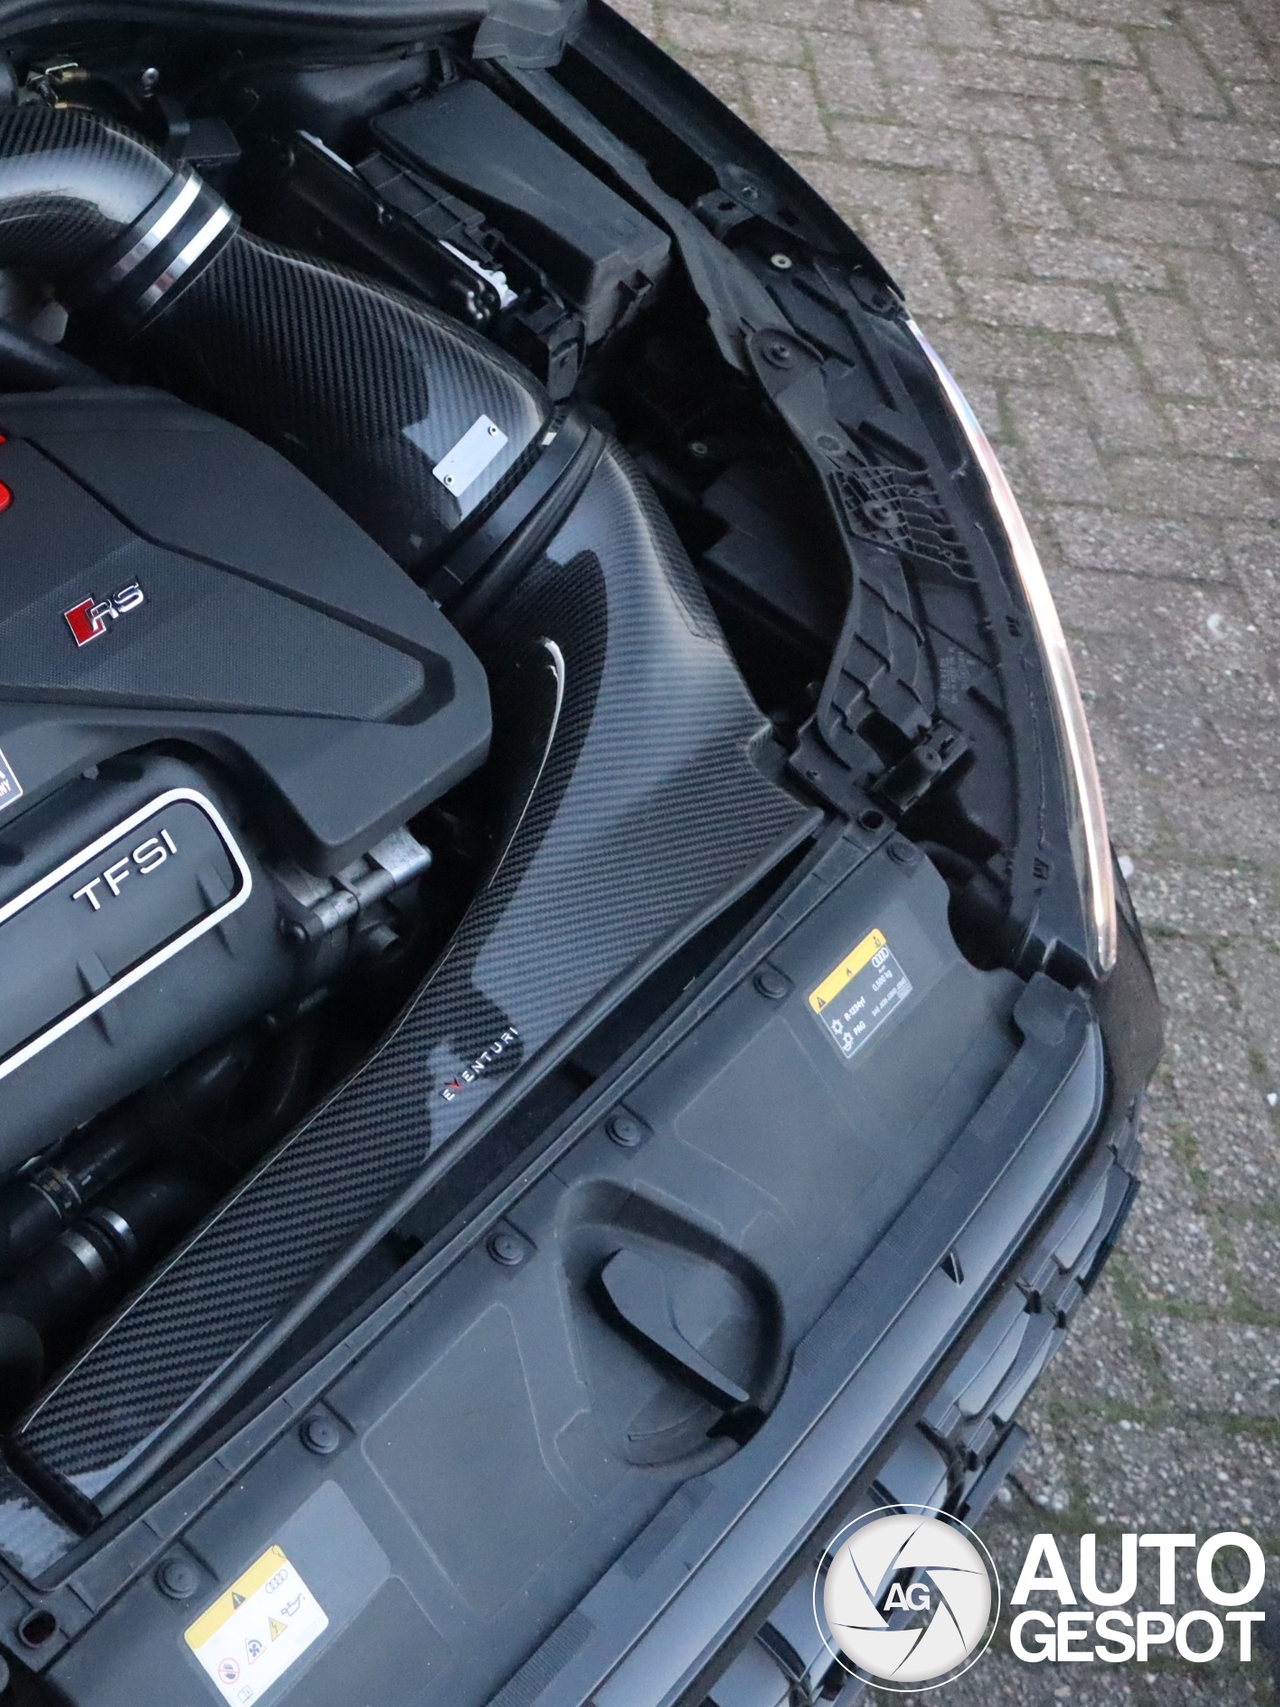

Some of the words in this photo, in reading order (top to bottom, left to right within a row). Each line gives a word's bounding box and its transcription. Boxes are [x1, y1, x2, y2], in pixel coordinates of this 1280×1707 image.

[86, 581, 144, 634] RS
[72, 828, 178, 911] TFSI
[852, 1020, 867, 1036] PAG
[442, 1026, 519, 1102] EVENTURI
